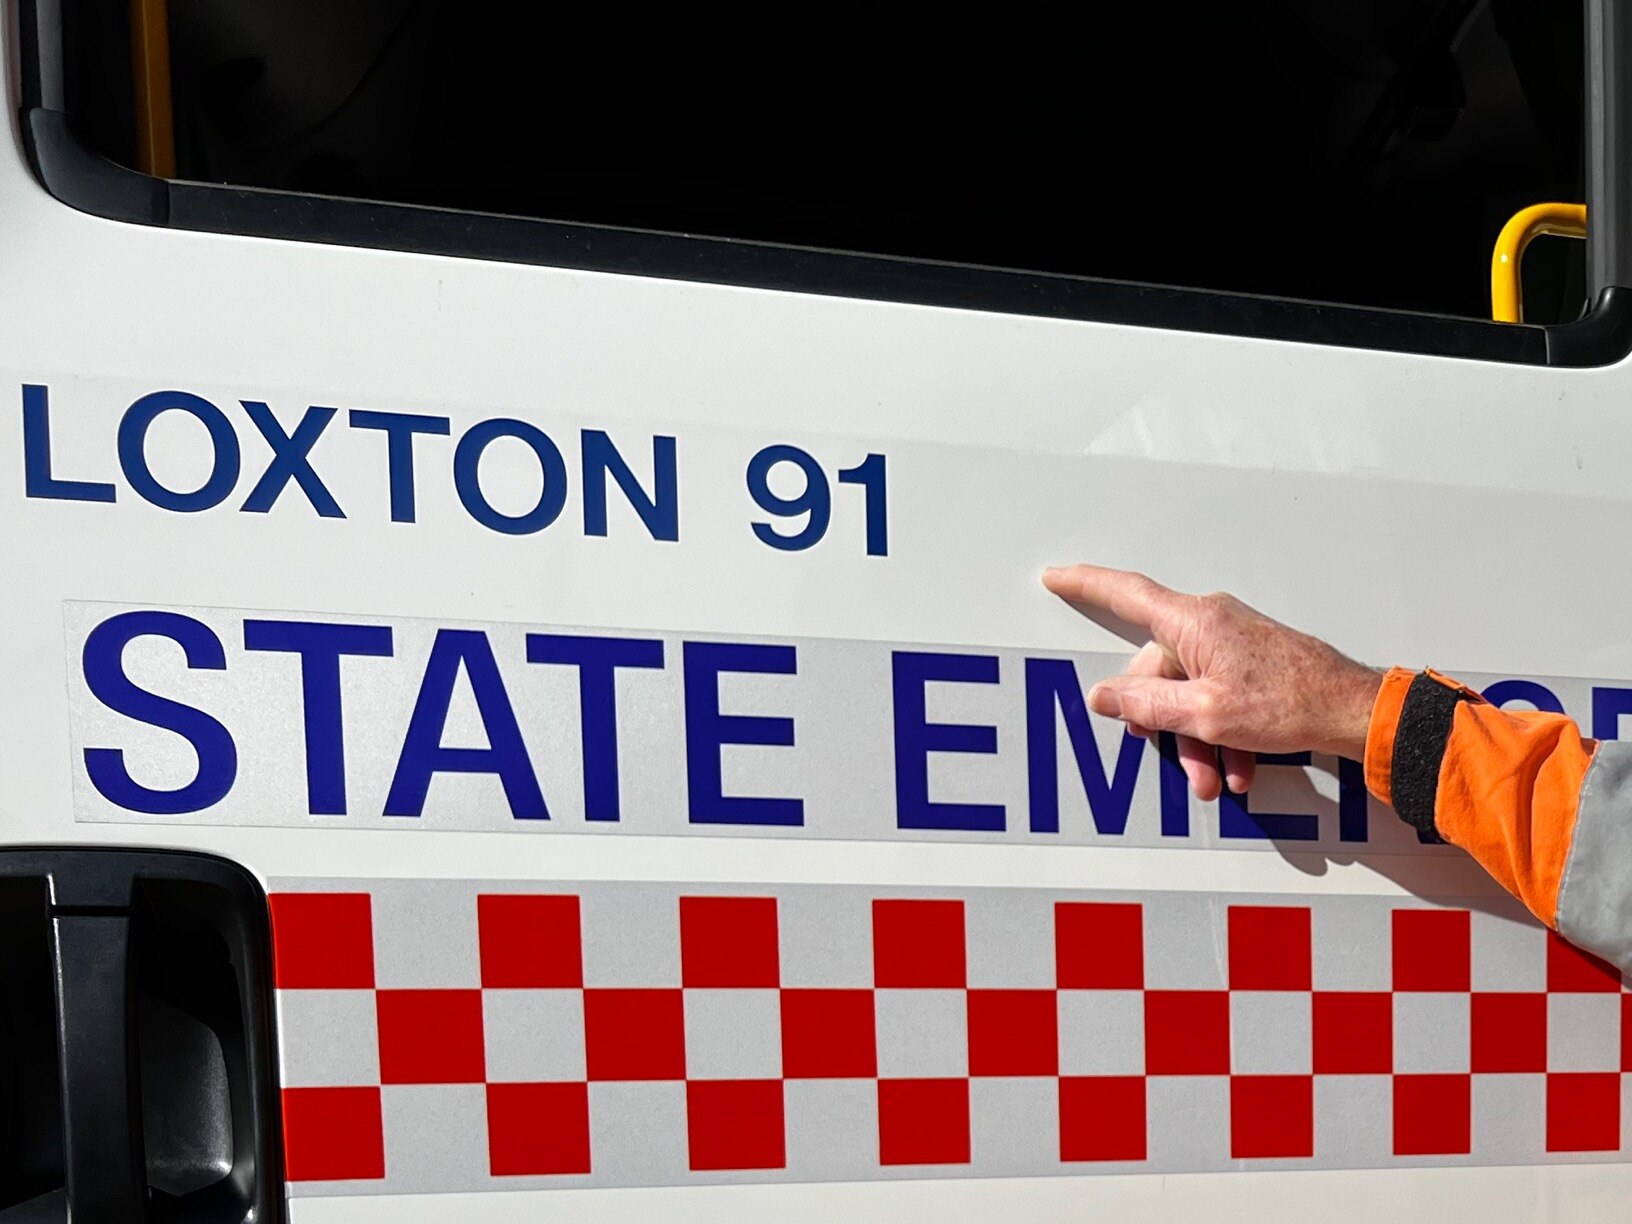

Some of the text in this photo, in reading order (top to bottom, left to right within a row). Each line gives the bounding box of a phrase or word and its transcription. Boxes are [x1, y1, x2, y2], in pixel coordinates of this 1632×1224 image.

[22, 383, 890, 557] LOXTON 91
[82, 610, 806, 828] STATE
